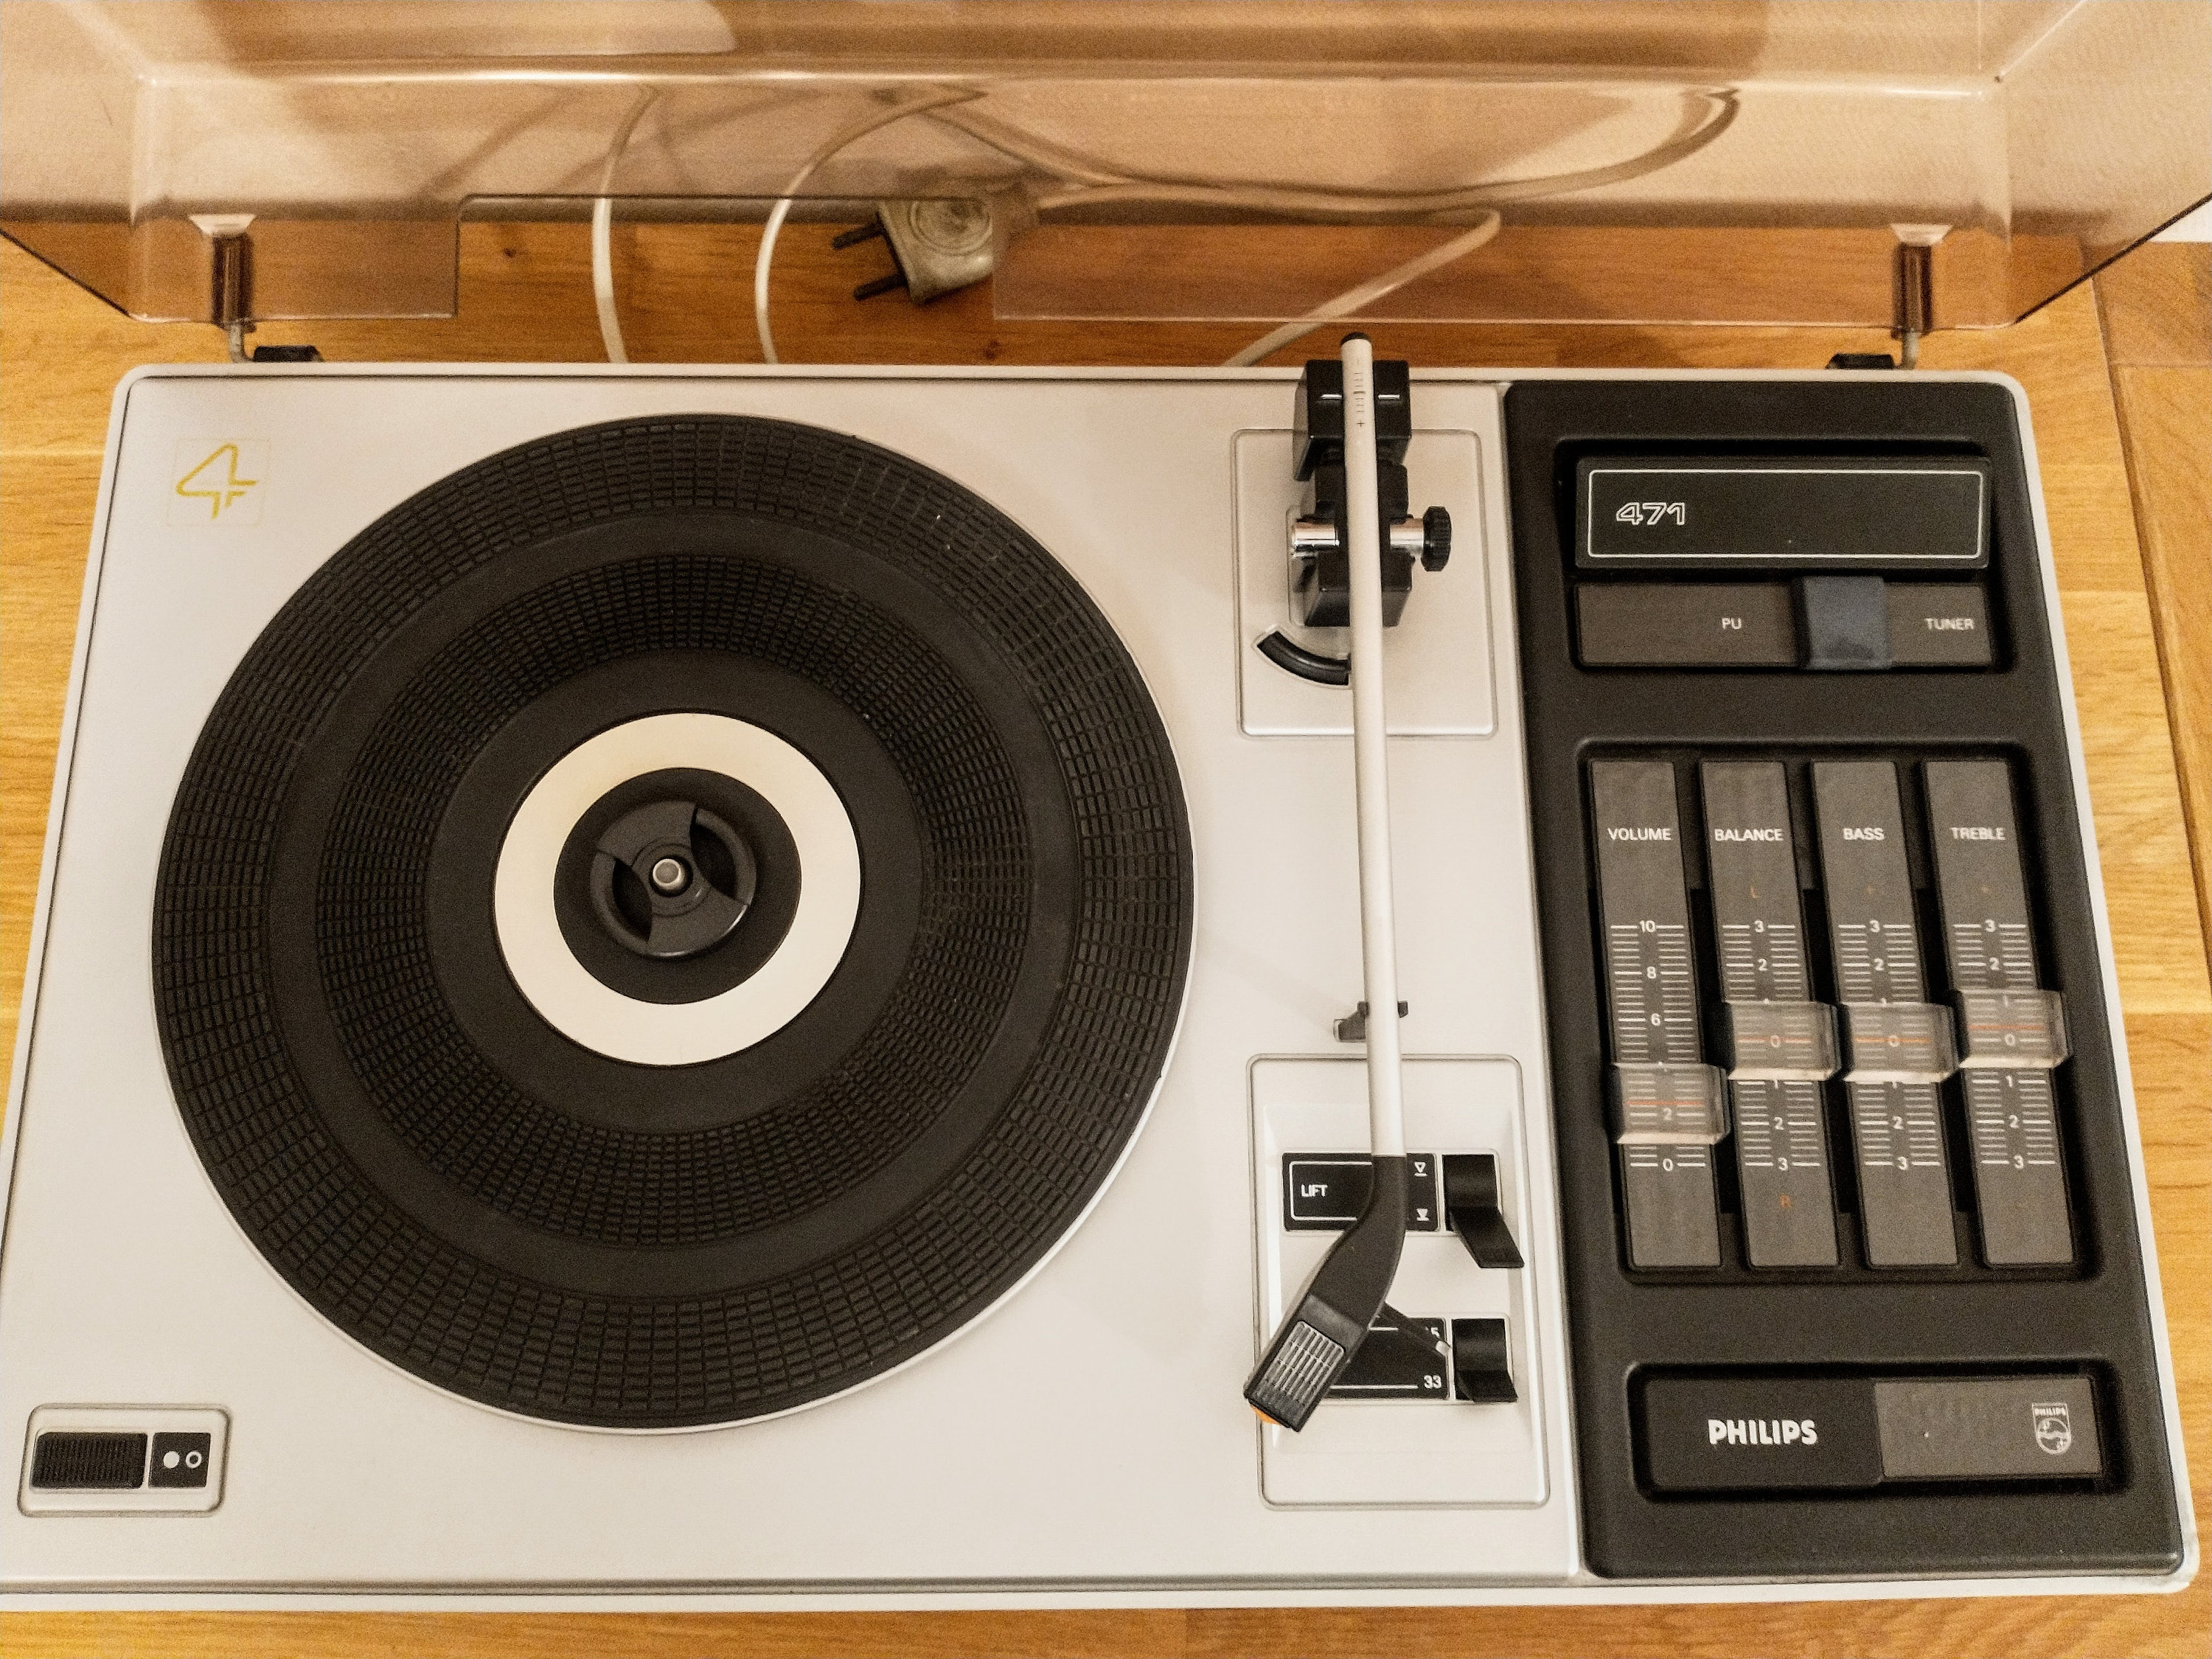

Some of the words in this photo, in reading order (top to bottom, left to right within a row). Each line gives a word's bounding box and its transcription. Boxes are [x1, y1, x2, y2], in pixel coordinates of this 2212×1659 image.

[1615, 501, 1686, 525] 471
[1721, 618, 1742, 630] PU
[1925, 618, 1974, 631] TUNER
[1607, 827, 1671, 841] VOLUME
[1714, 829, 1784, 841] BALANCE
[1843, 827, 1885, 840] BASS
[1950, 827, 2006, 840] TREBLE
[1640, 920, 1656, 933] 10
[1754, 920, 1764, 933] 3
[1870, 920, 1879, 933] 3
[1985, 919, 1996, 932] 3
[1758, 959, 1767, 971] 2
[1874, 958, 1884, 971] 2
[1990, 957, 2000, 970] 2
[1646, 966, 1657, 979] 8
[1651, 1013, 1661, 1026] 6
[1771, 1034, 1781, 1048] 0
[1889, 1034, 1899, 1047] 0
[2005, 1033, 2015, 1046] 0
[2006, 1075, 2013, 1088] 1
[1663, 1107, 1672, 1121] 2
[1773, 1116, 1784, 1130] 2
[1893, 1116, 1904, 1129] 2
[2008, 1115, 2020, 1128] 2
[1662, 1158, 1673, 1172] 0
[1778, 1157, 1788, 1171] 3
[1897, 1156, 1908, 1171] 3
[2014, 1155, 2024, 1169] 3
[1301, 1183, 1328, 1197] LIFT
[1424, 1374, 1442, 1389] 33
[1708, 1419, 1818, 1446] PHILIPS
